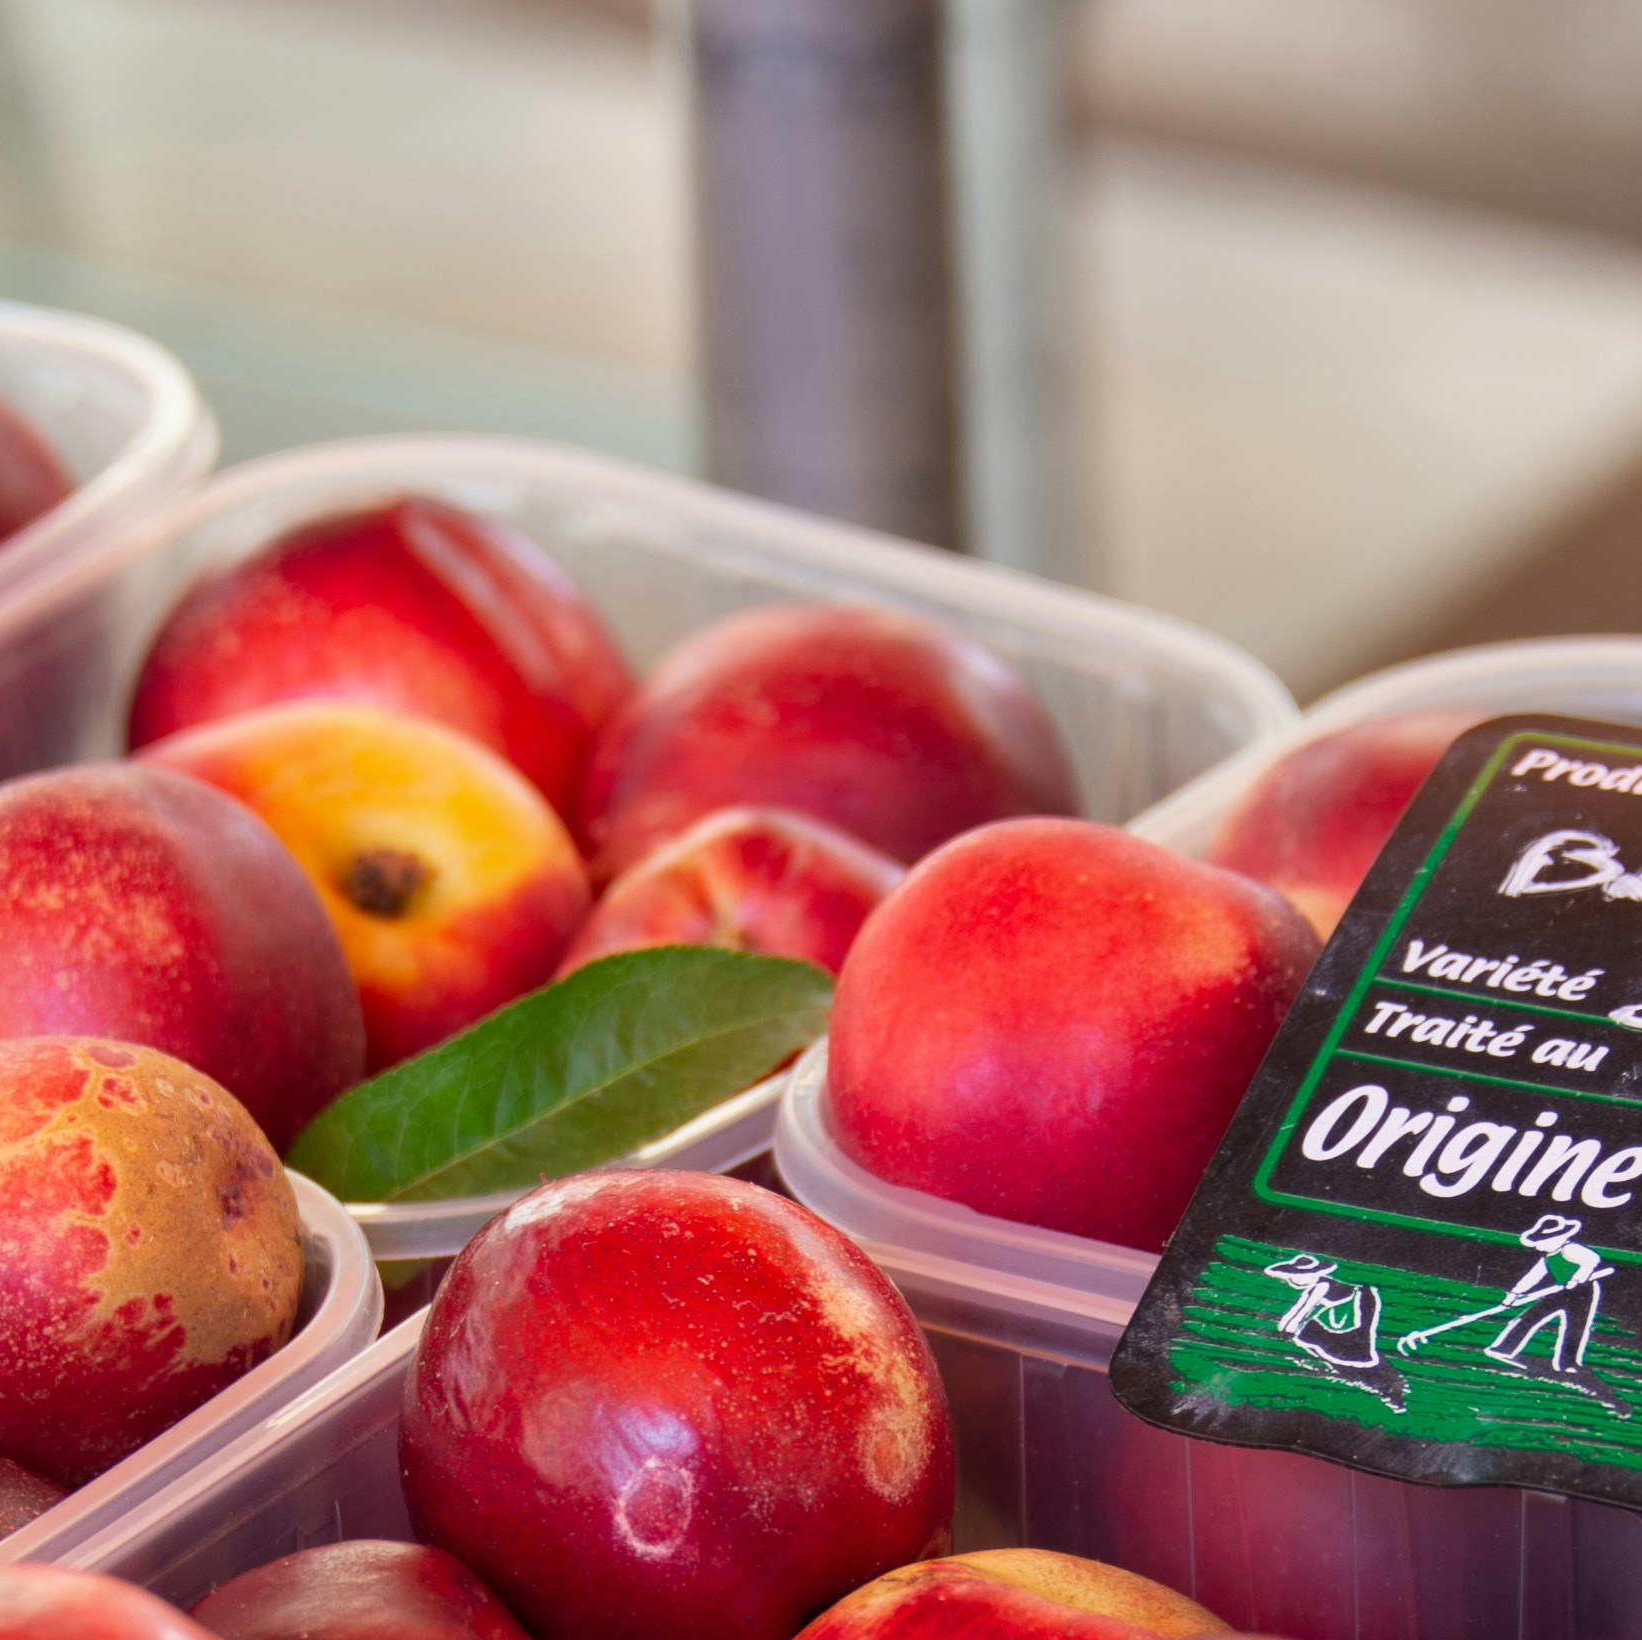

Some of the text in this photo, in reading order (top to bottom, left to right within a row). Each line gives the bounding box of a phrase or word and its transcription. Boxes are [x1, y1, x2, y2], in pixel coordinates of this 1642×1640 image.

[1400, 939, 1605, 1002] Variété
[1363, 1000, 1611, 1072] Traité au
